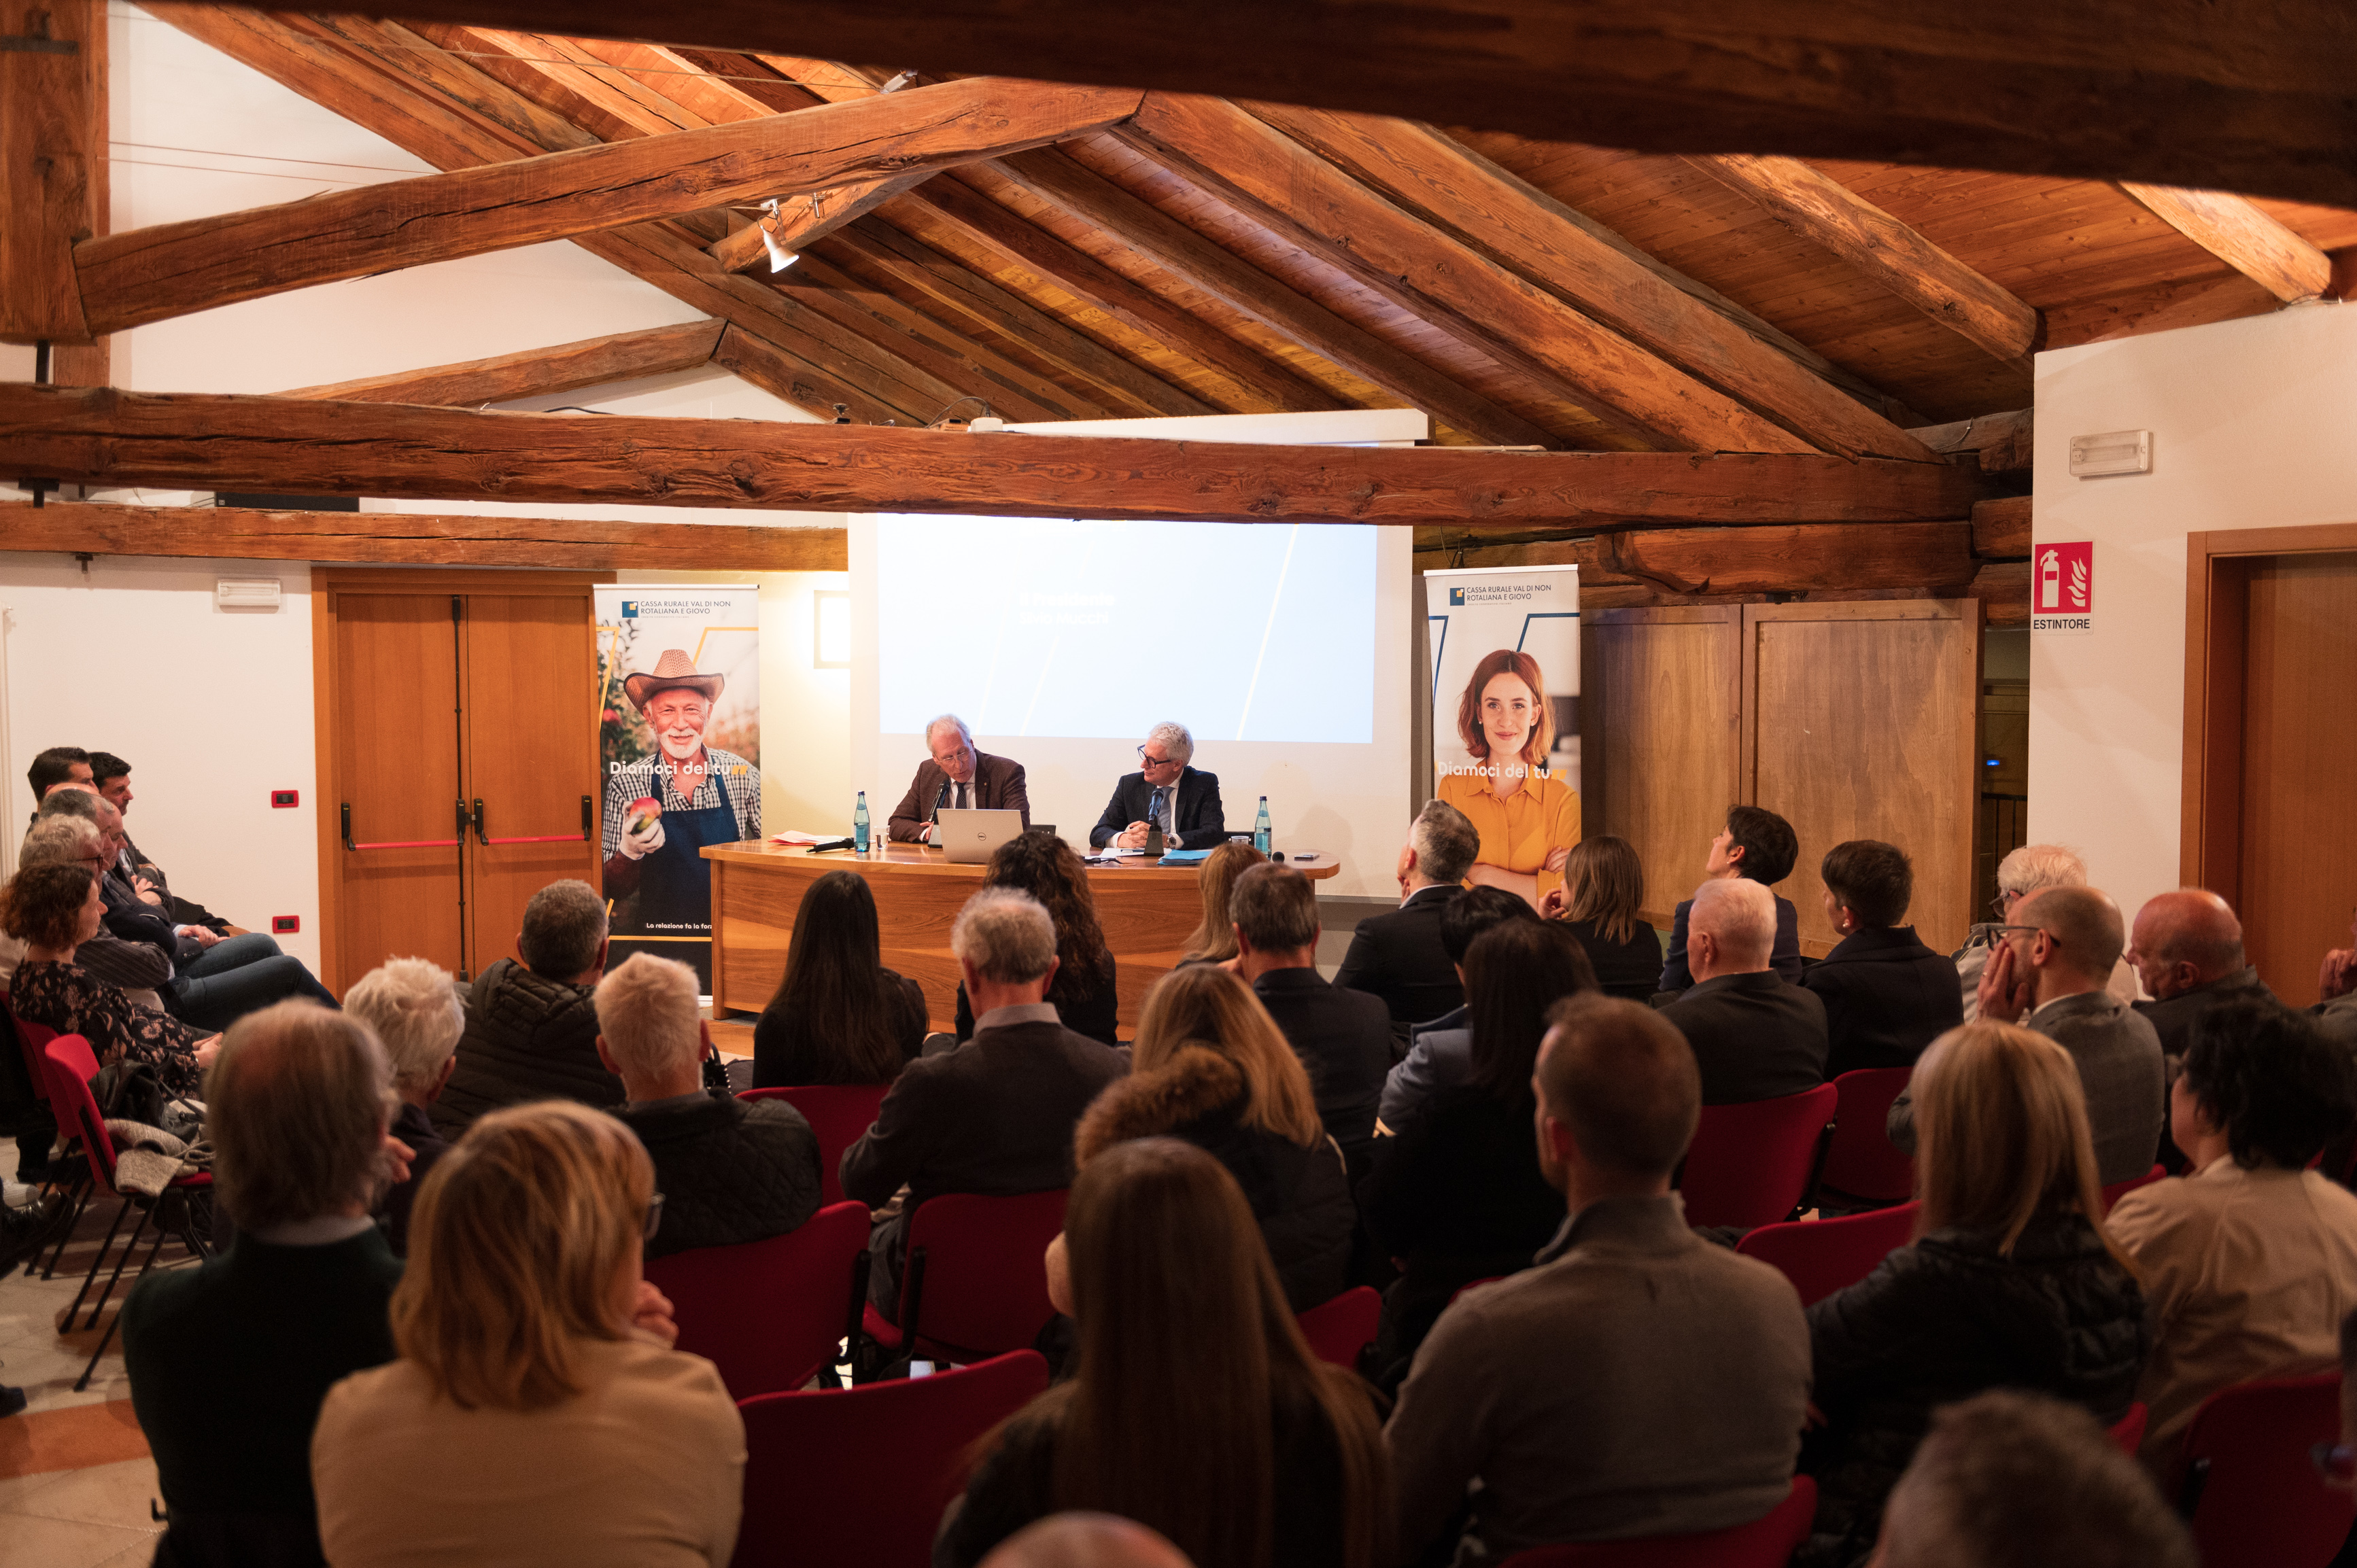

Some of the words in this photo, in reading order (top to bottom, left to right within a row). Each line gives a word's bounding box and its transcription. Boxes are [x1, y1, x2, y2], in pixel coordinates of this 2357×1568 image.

[1019, 610, 1052, 625] Silvio
[1056, 611, 1109, 625] Mucchi
[2033, 619, 2091, 629] ESTINTORE
[610, 761, 678, 775] Diamoci
[683, 761, 708, 775] del
[1438, 761, 1500, 778] Diamoci
[1504, 763, 1529, 778] del
